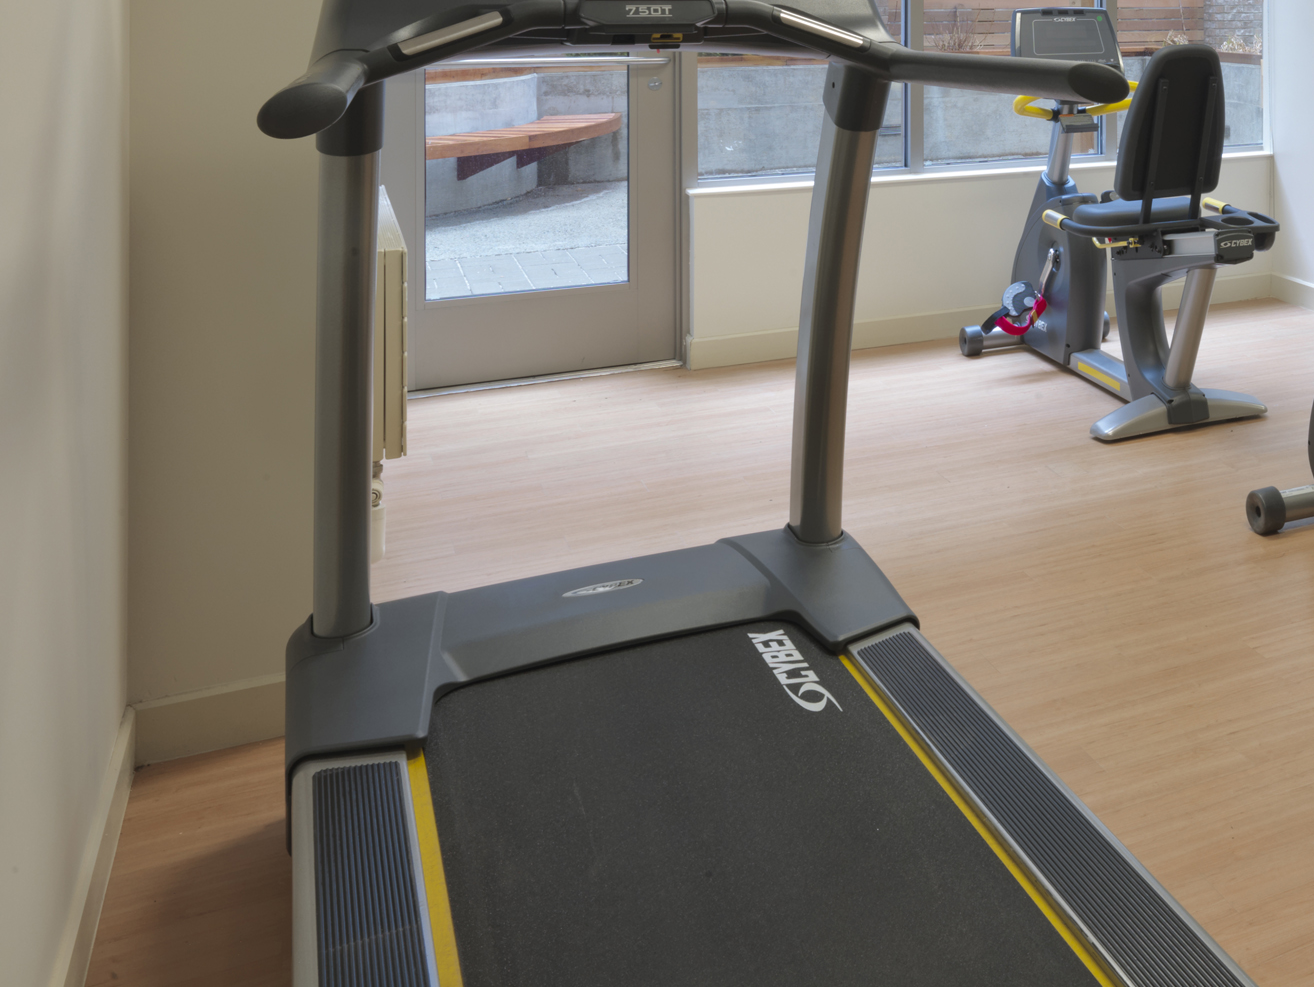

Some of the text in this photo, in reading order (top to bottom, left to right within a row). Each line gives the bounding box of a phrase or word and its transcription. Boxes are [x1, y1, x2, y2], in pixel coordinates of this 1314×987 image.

[626, 5, 672, 16] 750T
[1231, 238, 1253, 247] CYBEX
[747, 629, 820, 685] CYBEX
